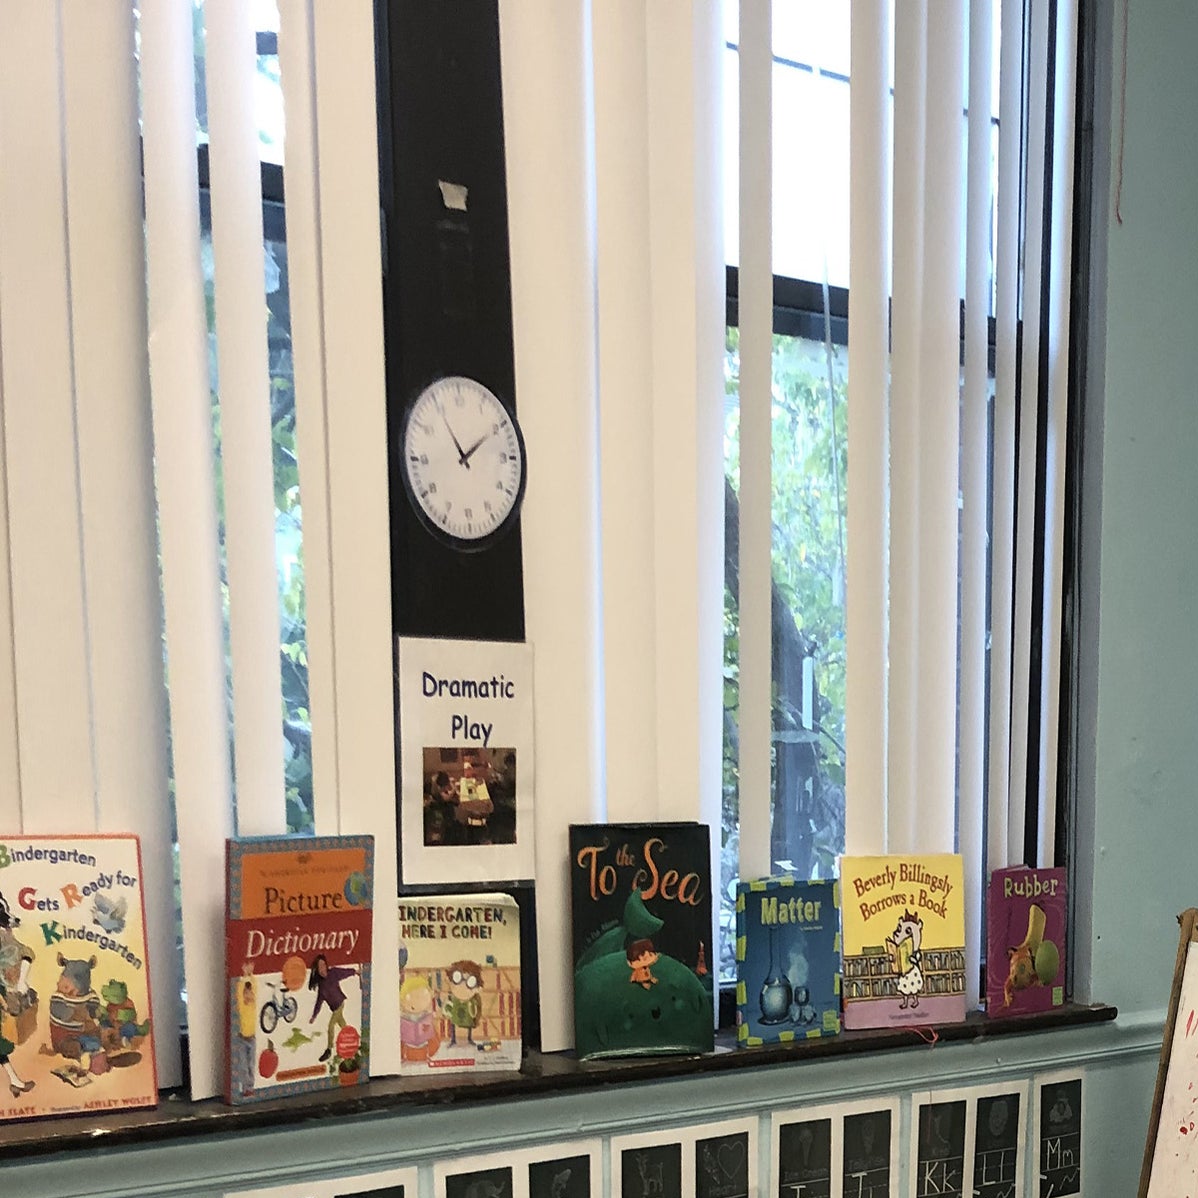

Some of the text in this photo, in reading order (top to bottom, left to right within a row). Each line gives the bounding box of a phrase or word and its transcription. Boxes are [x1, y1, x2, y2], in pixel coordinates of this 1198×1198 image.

[422, 671, 514, 698] Dramatic
[451, 714, 494, 748] Play
[578, 836, 705, 906] To the Sea
[853, 863, 953, 900] Beverly Billingsly
[1004, 876, 1059, 898] Rubber
[18, 870, 137, 912] Gets Ready for
[264, 887, 343, 915] Picture
[860, 889, 948, 922] Borrows a Book
[399, 905, 507, 926] INDERGARTEN,
[761, 897, 822, 925] Matter
[40, 920, 142, 971] Kindergarten
[246, 926, 360, 959] Dictionary
[402, 924, 492, 939] HERE I COME!
